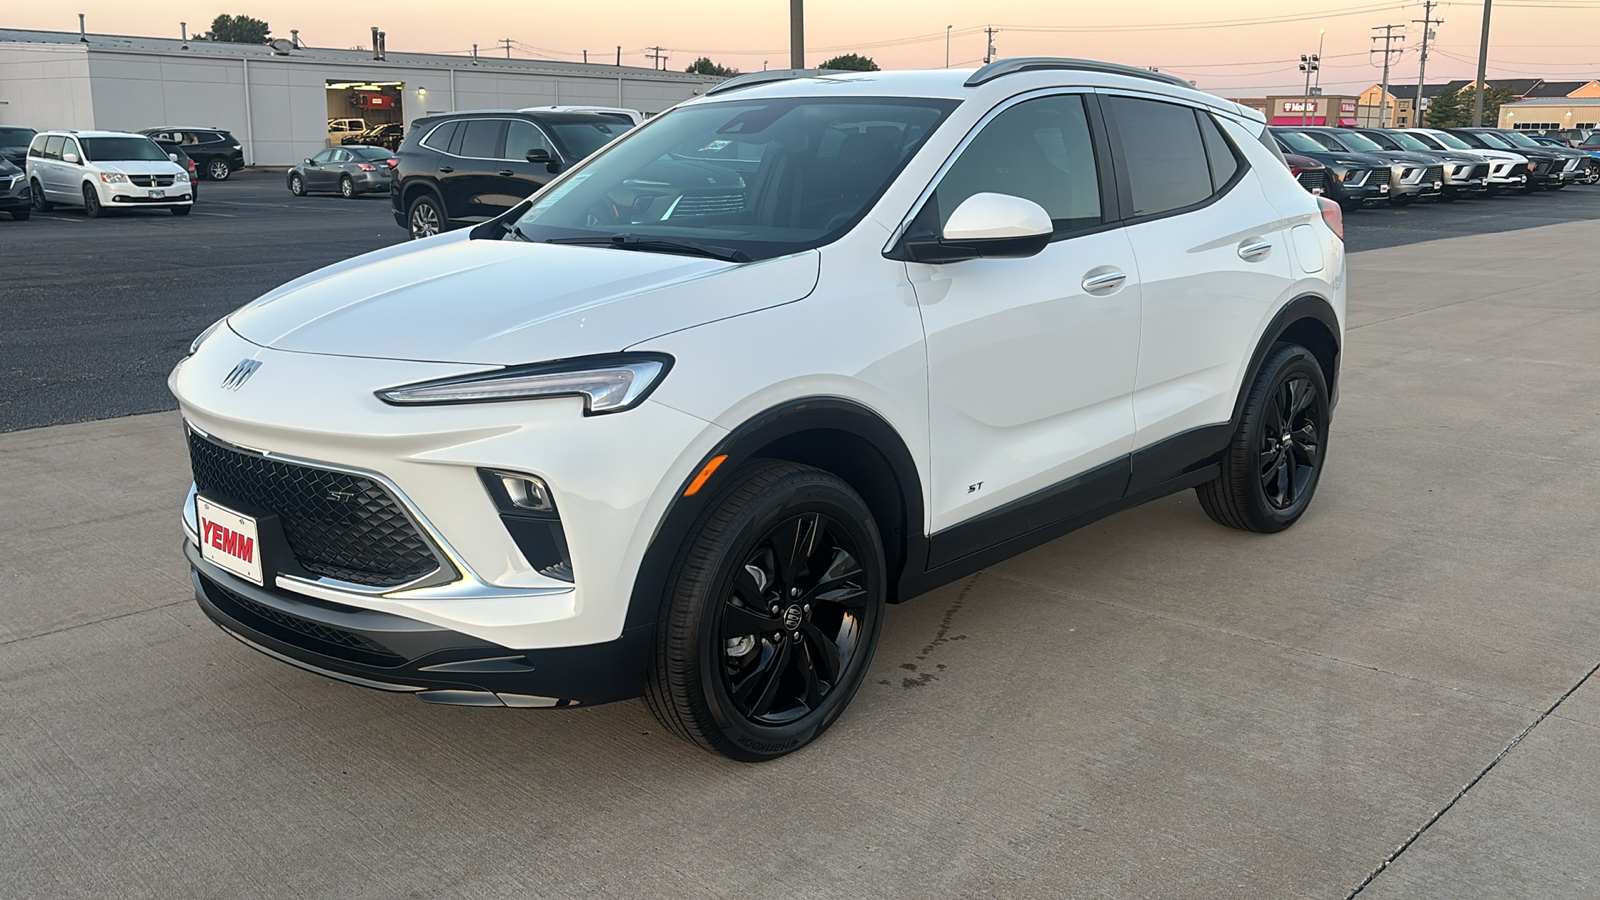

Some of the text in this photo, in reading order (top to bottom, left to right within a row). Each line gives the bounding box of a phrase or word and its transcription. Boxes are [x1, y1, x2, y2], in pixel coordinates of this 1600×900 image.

[967, 480, 984, 493] ST
[326, 490, 354, 502] ST
[201, 516, 254, 564] YEMM
